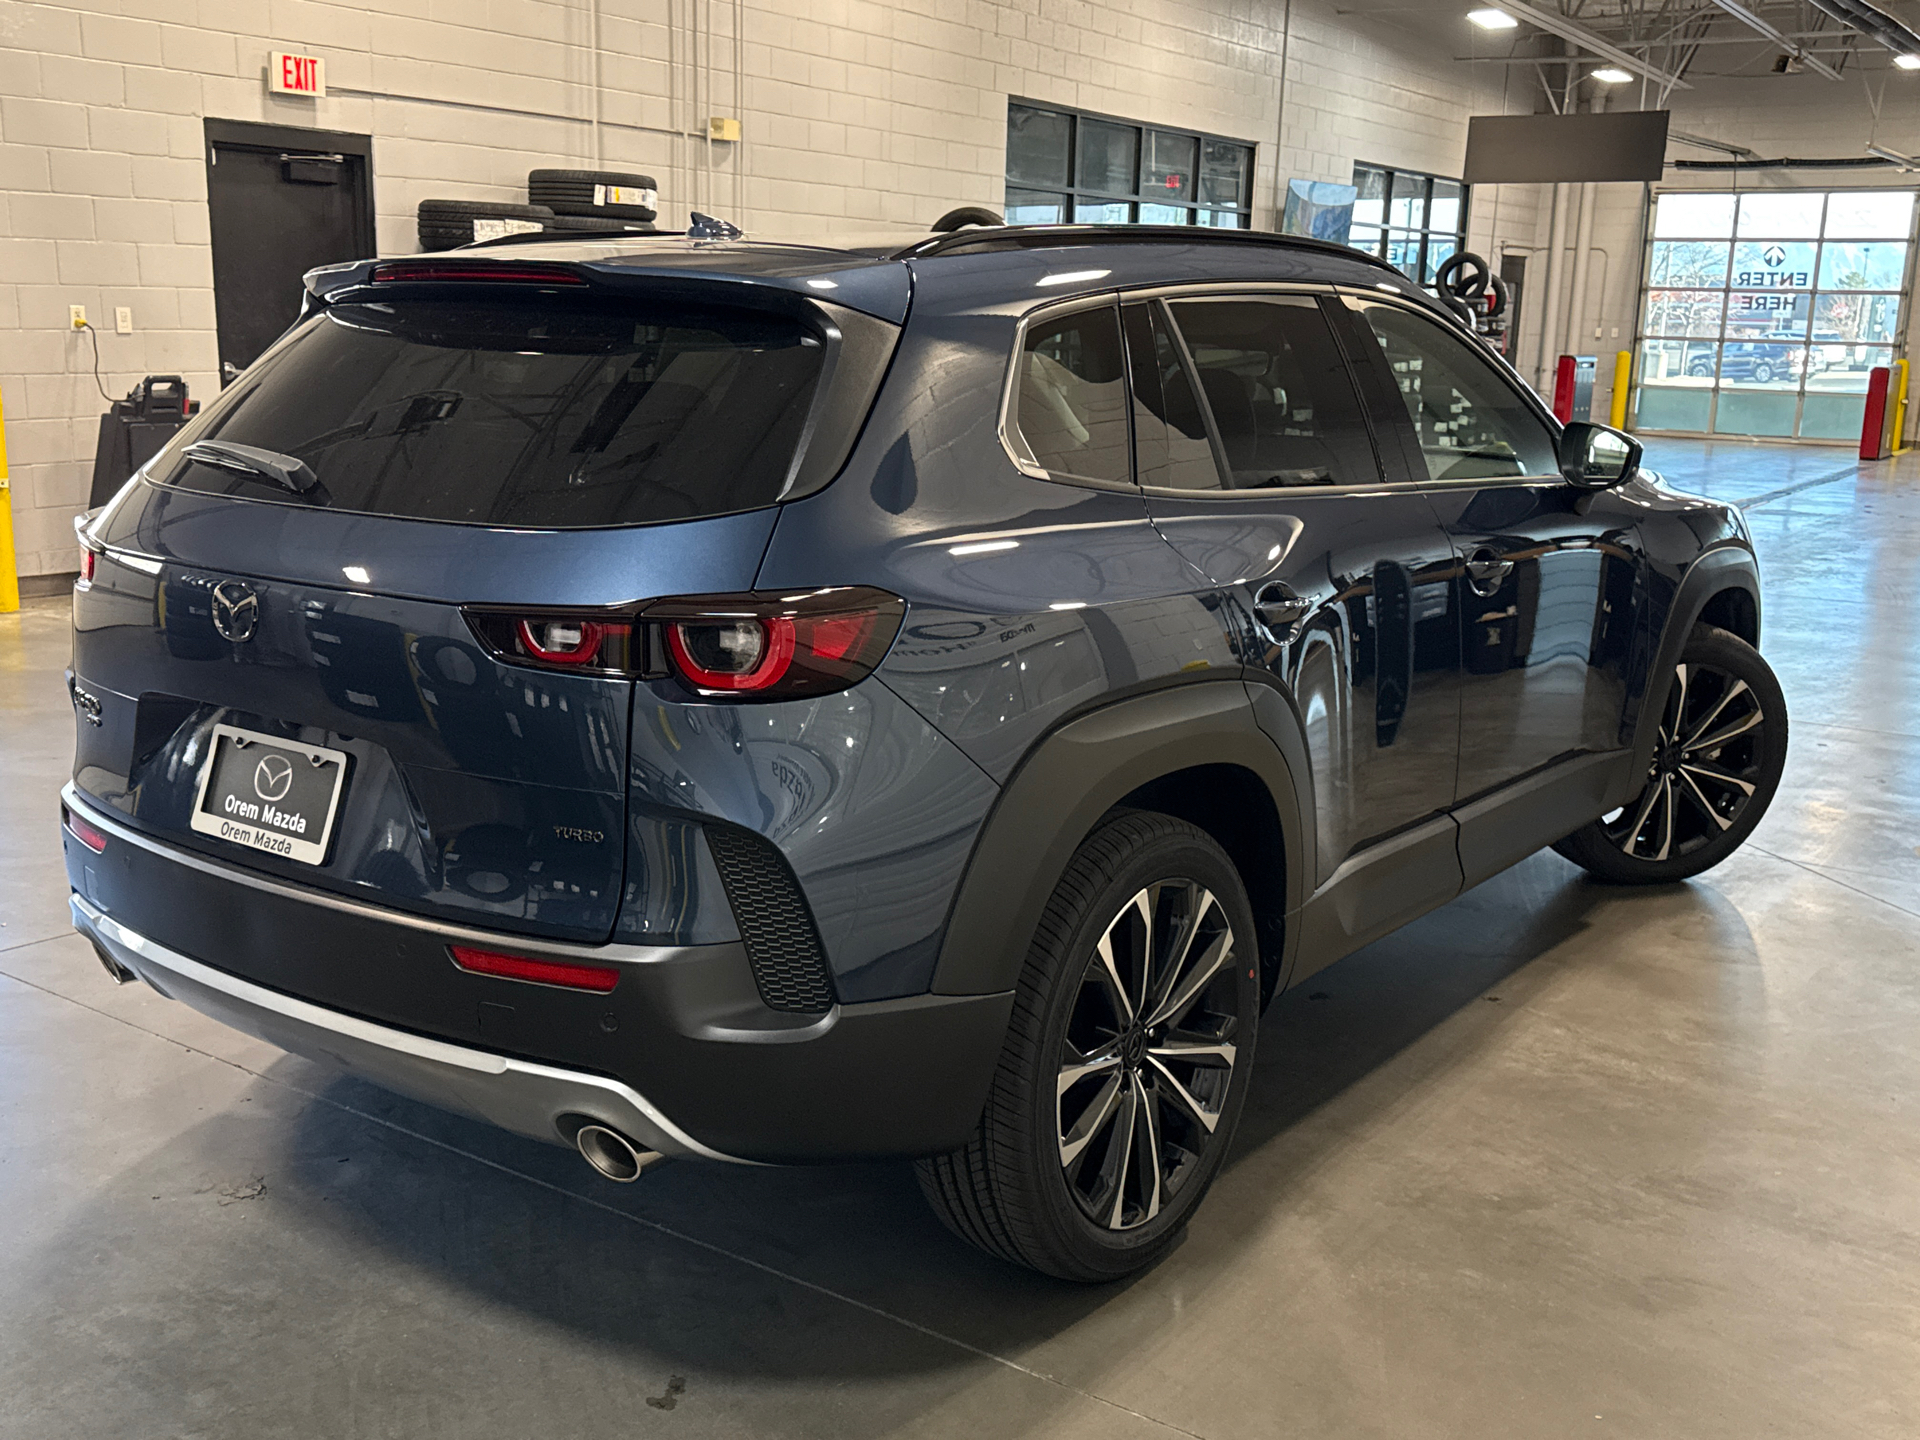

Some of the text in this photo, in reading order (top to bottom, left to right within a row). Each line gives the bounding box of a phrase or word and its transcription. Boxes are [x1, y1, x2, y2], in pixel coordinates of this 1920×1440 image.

[282, 55, 317, 91] EXIT
[225, 794, 307, 833] Orem Mazda
[220, 821, 292, 855] Orem Mazda
[553, 825, 604, 843] TURBO
